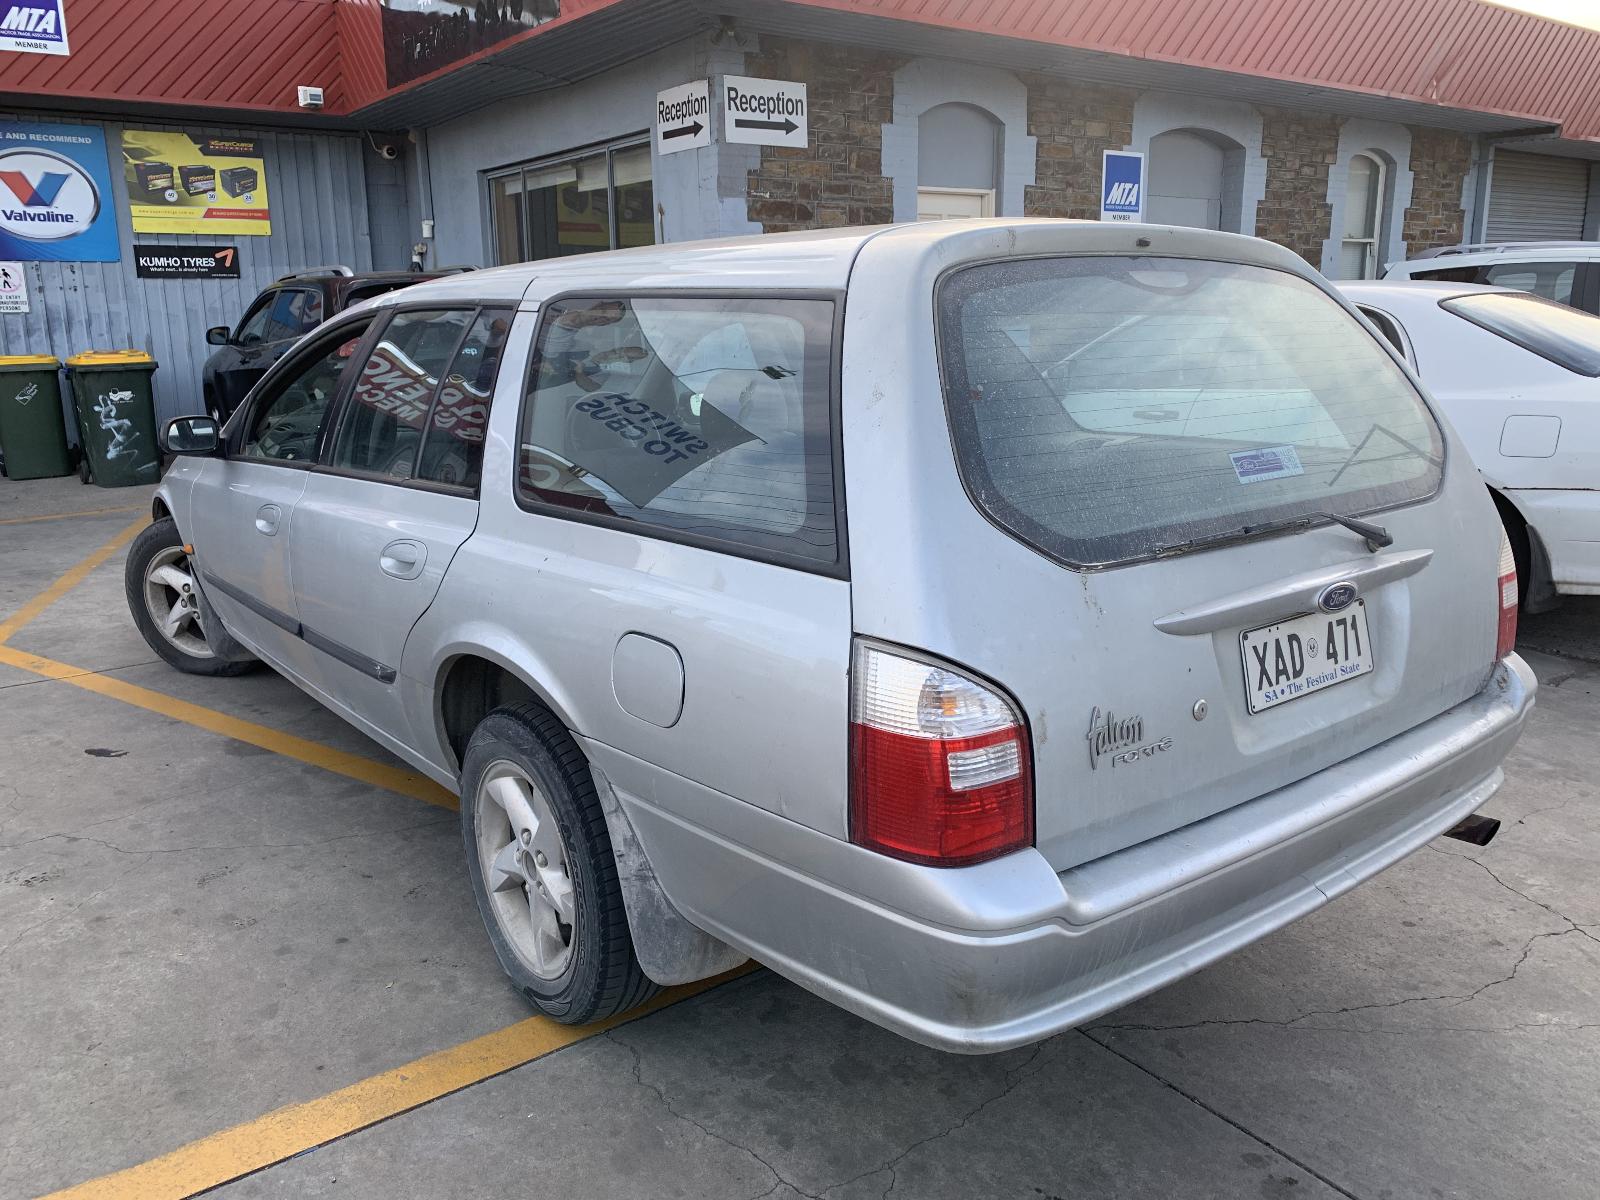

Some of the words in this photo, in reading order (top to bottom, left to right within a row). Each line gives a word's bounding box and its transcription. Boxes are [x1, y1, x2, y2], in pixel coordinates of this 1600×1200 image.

[0, 6, 56, 34] MTA
[15, 41, 49, 50] MEMBER
[658, 93, 708, 124] Reception
[727, 86, 804, 120] Reception
[6, 132, 27, 140] AND
[29, 134, 92, 144] RECOMMEND
[1105, 182, 1139, 205] MTA
[2, 209, 74, 223] Valvoline
[139, 257, 180, 267] KUMHO
[182, 257, 216, 267] TYRES
[1329, 589, 1350, 606] Ford
[1252, 633, 1305, 692] XAD
[1327, 614, 1361, 665] 471
[1264, 689, 1279, 703] SA
[1287, 683, 1303, 695] The
[1306, 667, 1338, 688] Festival
[1340, 662, 1361, 677] State
